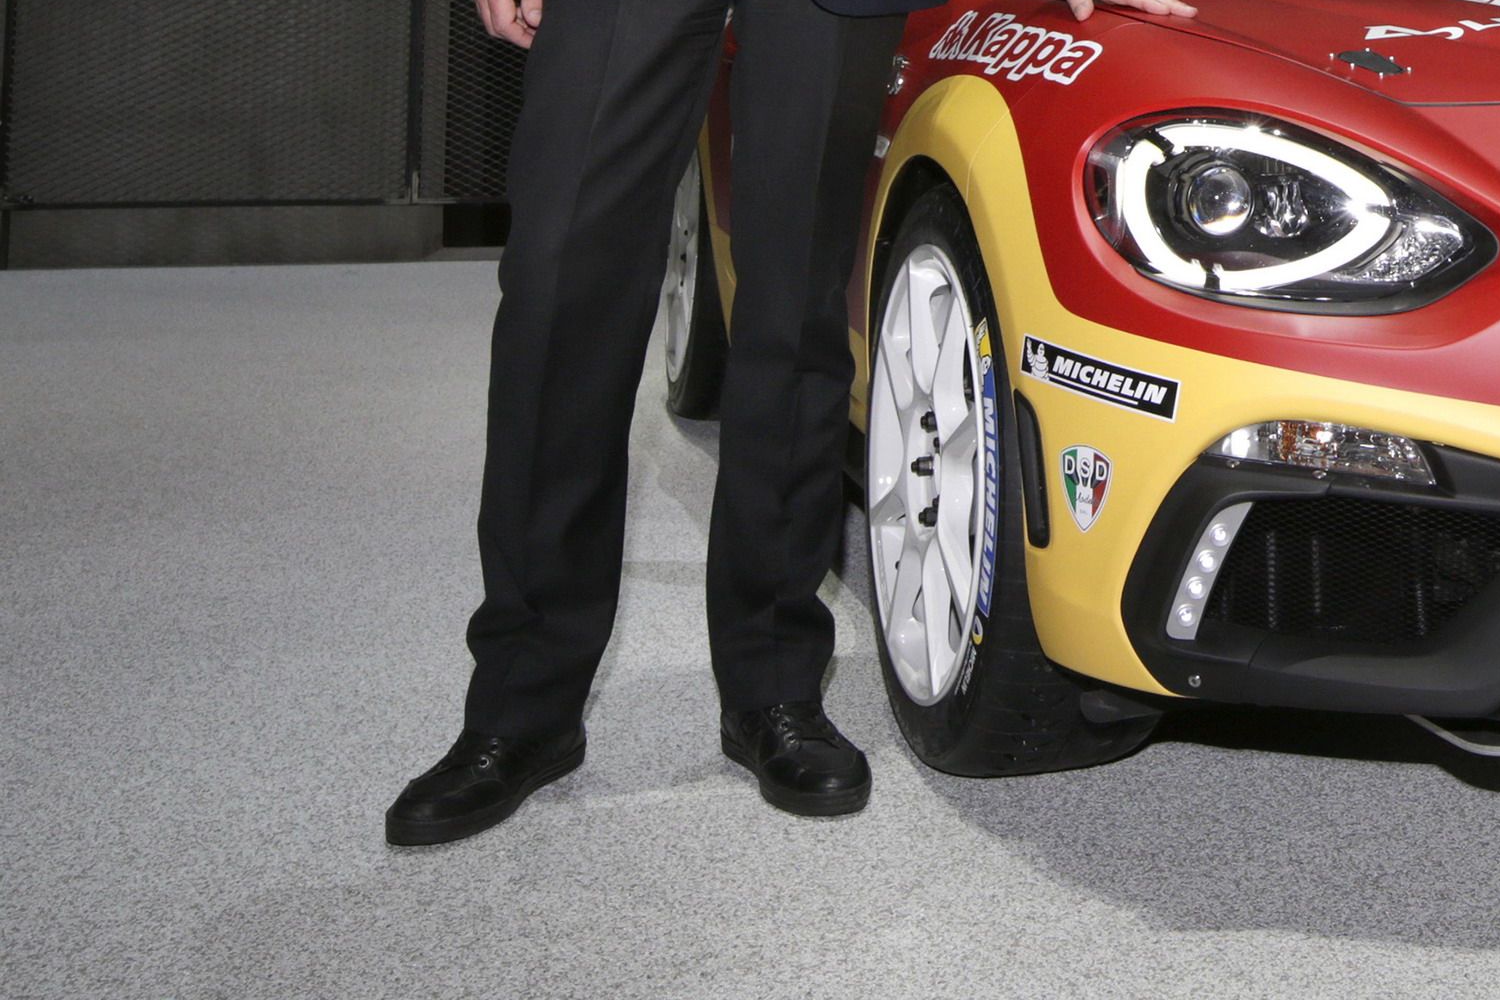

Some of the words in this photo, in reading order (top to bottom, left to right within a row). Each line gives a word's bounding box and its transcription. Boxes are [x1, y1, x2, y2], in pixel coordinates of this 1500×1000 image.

[960, 12, 1103, 85] Kappa
[1052, 355, 1168, 405] MICHELIN
[1064, 454, 1108, 481] DSD
[979, 397, 996, 606] MICHELIN
